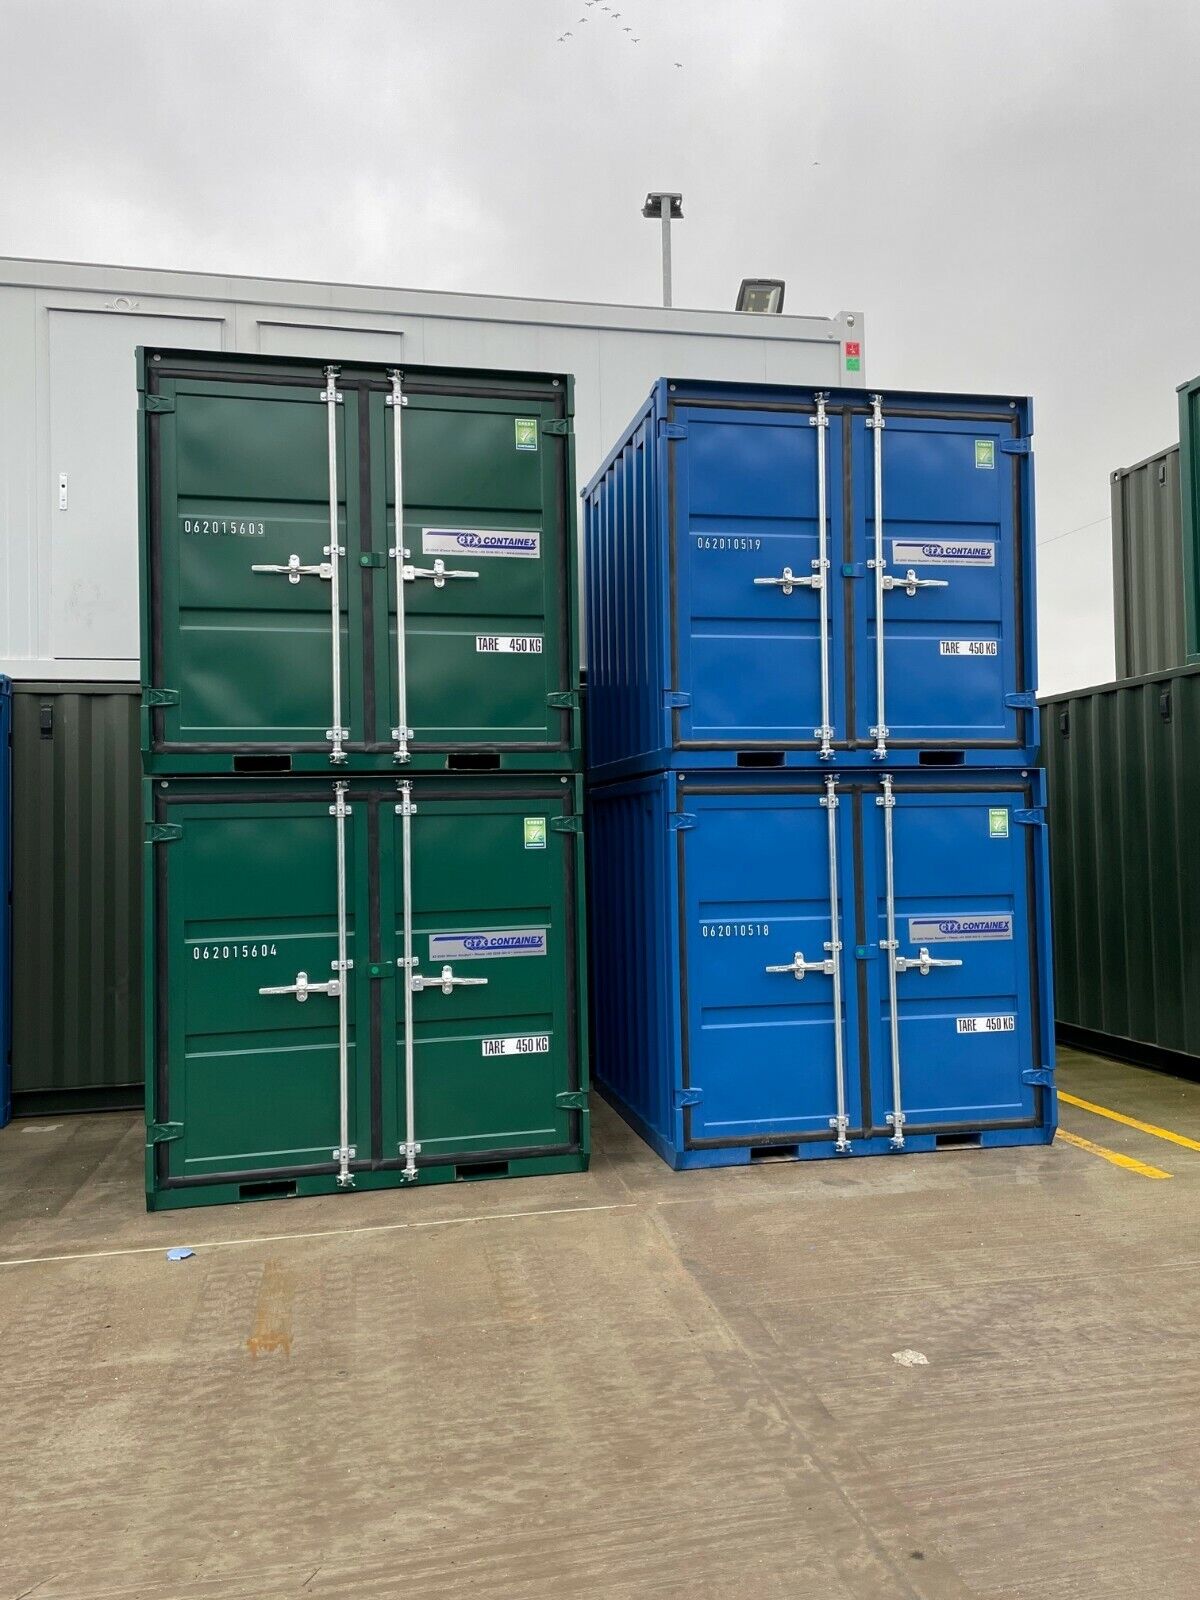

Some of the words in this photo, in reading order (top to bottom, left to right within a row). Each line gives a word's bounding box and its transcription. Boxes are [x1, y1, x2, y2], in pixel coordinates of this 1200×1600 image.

[184, 520, 264, 535] 062015603
[483, 536, 537, 546] CONTAINEX
[697, 537, 761, 550] 062010519
[945, 547, 992, 556] CONTAINEX
[477, 637, 500, 651] TARE
[509, 638, 527, 652] 450
[529, 638, 541, 652] KG
[941, 641, 960, 654] TARE
[968, 642, 984, 655] 450
[985, 642, 996, 655] KG
[702, 924, 769, 937] 062010518
[962, 921, 1010, 930] CONTAINEX
[490, 935, 544, 946] CONTAINEX
[193, 943, 277, 960] 062015604
[958, 1018, 977, 1032] TARE
[985, 1017, 1002, 1031] 450
[1003, 1016, 1014, 1030] KG
[483, 1040, 505, 1055] TARE
[515, 1038, 534, 1053] 450
[535, 1037, 548, 1051] KG
